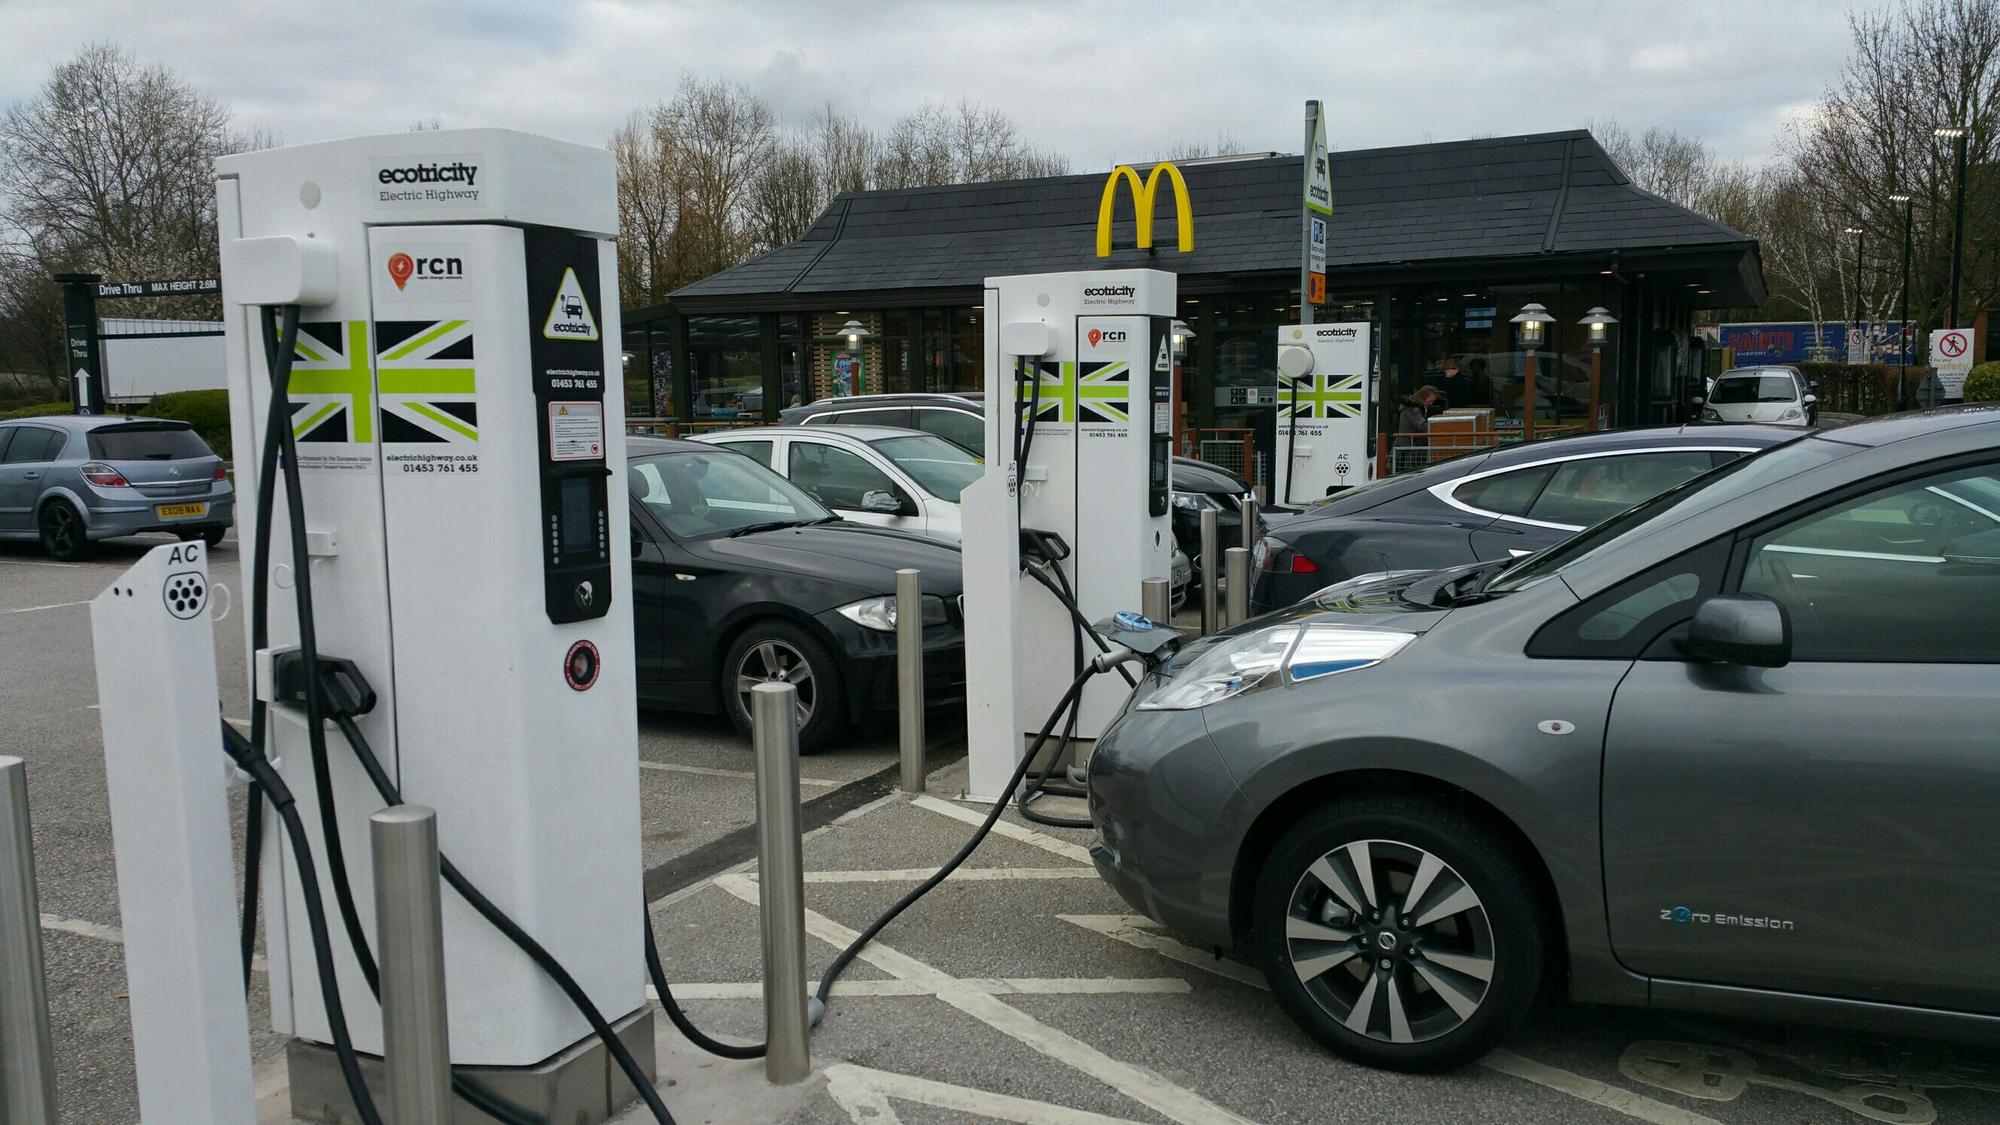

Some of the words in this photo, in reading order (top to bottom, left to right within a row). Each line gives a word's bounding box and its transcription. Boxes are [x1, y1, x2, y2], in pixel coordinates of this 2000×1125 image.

[378, 162, 478, 186] ecotricity
[379, 190, 423, 201] Electric
[425, 189, 479, 202] Highway
[416, 257, 463, 275] rcn
[100, 284, 121, 295] Drive
[123, 283, 143, 294] Thru
[151, 282, 168, 292] MAX
[170, 280, 197, 291] HEIGHT
[199, 279, 217, 290] 2.6M
[1084, 285, 1136, 298] ecotricity
[1107, 298, 1136, 306] Highway
[553, 322, 591, 337] ecotricity
[1316, 327, 1357, 338] ecotricity
[1102, 331, 1127, 341] rcn
[70, 338, 87, 347] Drive
[73, 349, 88, 358] Thru
[551, 379, 573, 388] 01453
[574, 379, 585, 389] 761
[586, 379, 598, 389] 455
[386, 454, 478, 464] electrichighway.co.uk
[403, 464, 434, 473] 01453
[437, 464, 455, 473] 761
[459, 464, 478, 473] 455
[168, 544, 198, 566] AC
[1715, 914, 1794, 930] Emission
